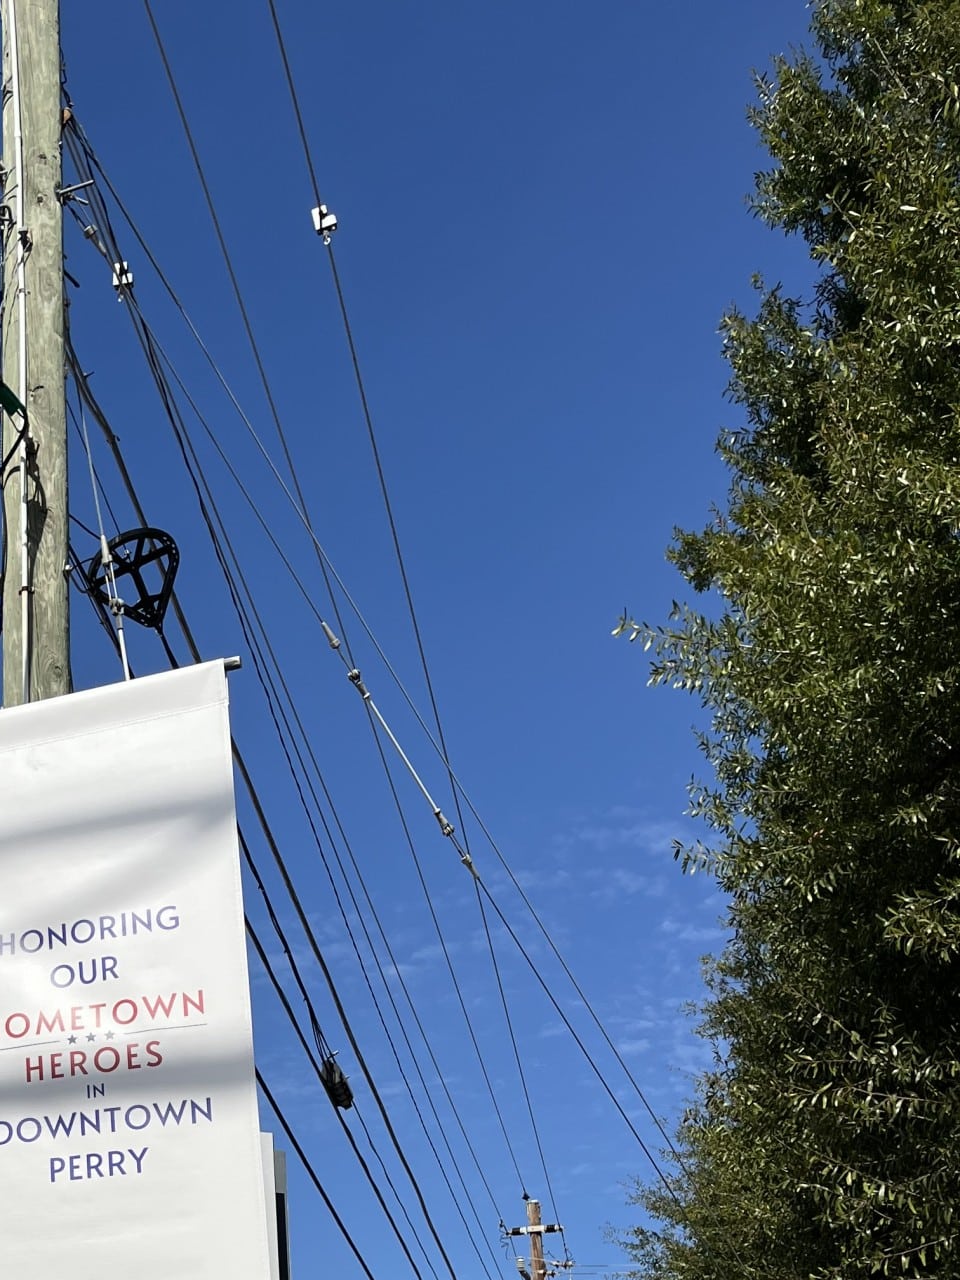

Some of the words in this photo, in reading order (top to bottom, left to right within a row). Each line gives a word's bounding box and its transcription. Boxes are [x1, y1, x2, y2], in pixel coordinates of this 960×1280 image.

[50, 956, 119, 988] OUR
[25, 1040, 163, 1083] HEROES
[86, 1083, 105, 1099] IN
[49, 1147, 148, 1183] PERRY
